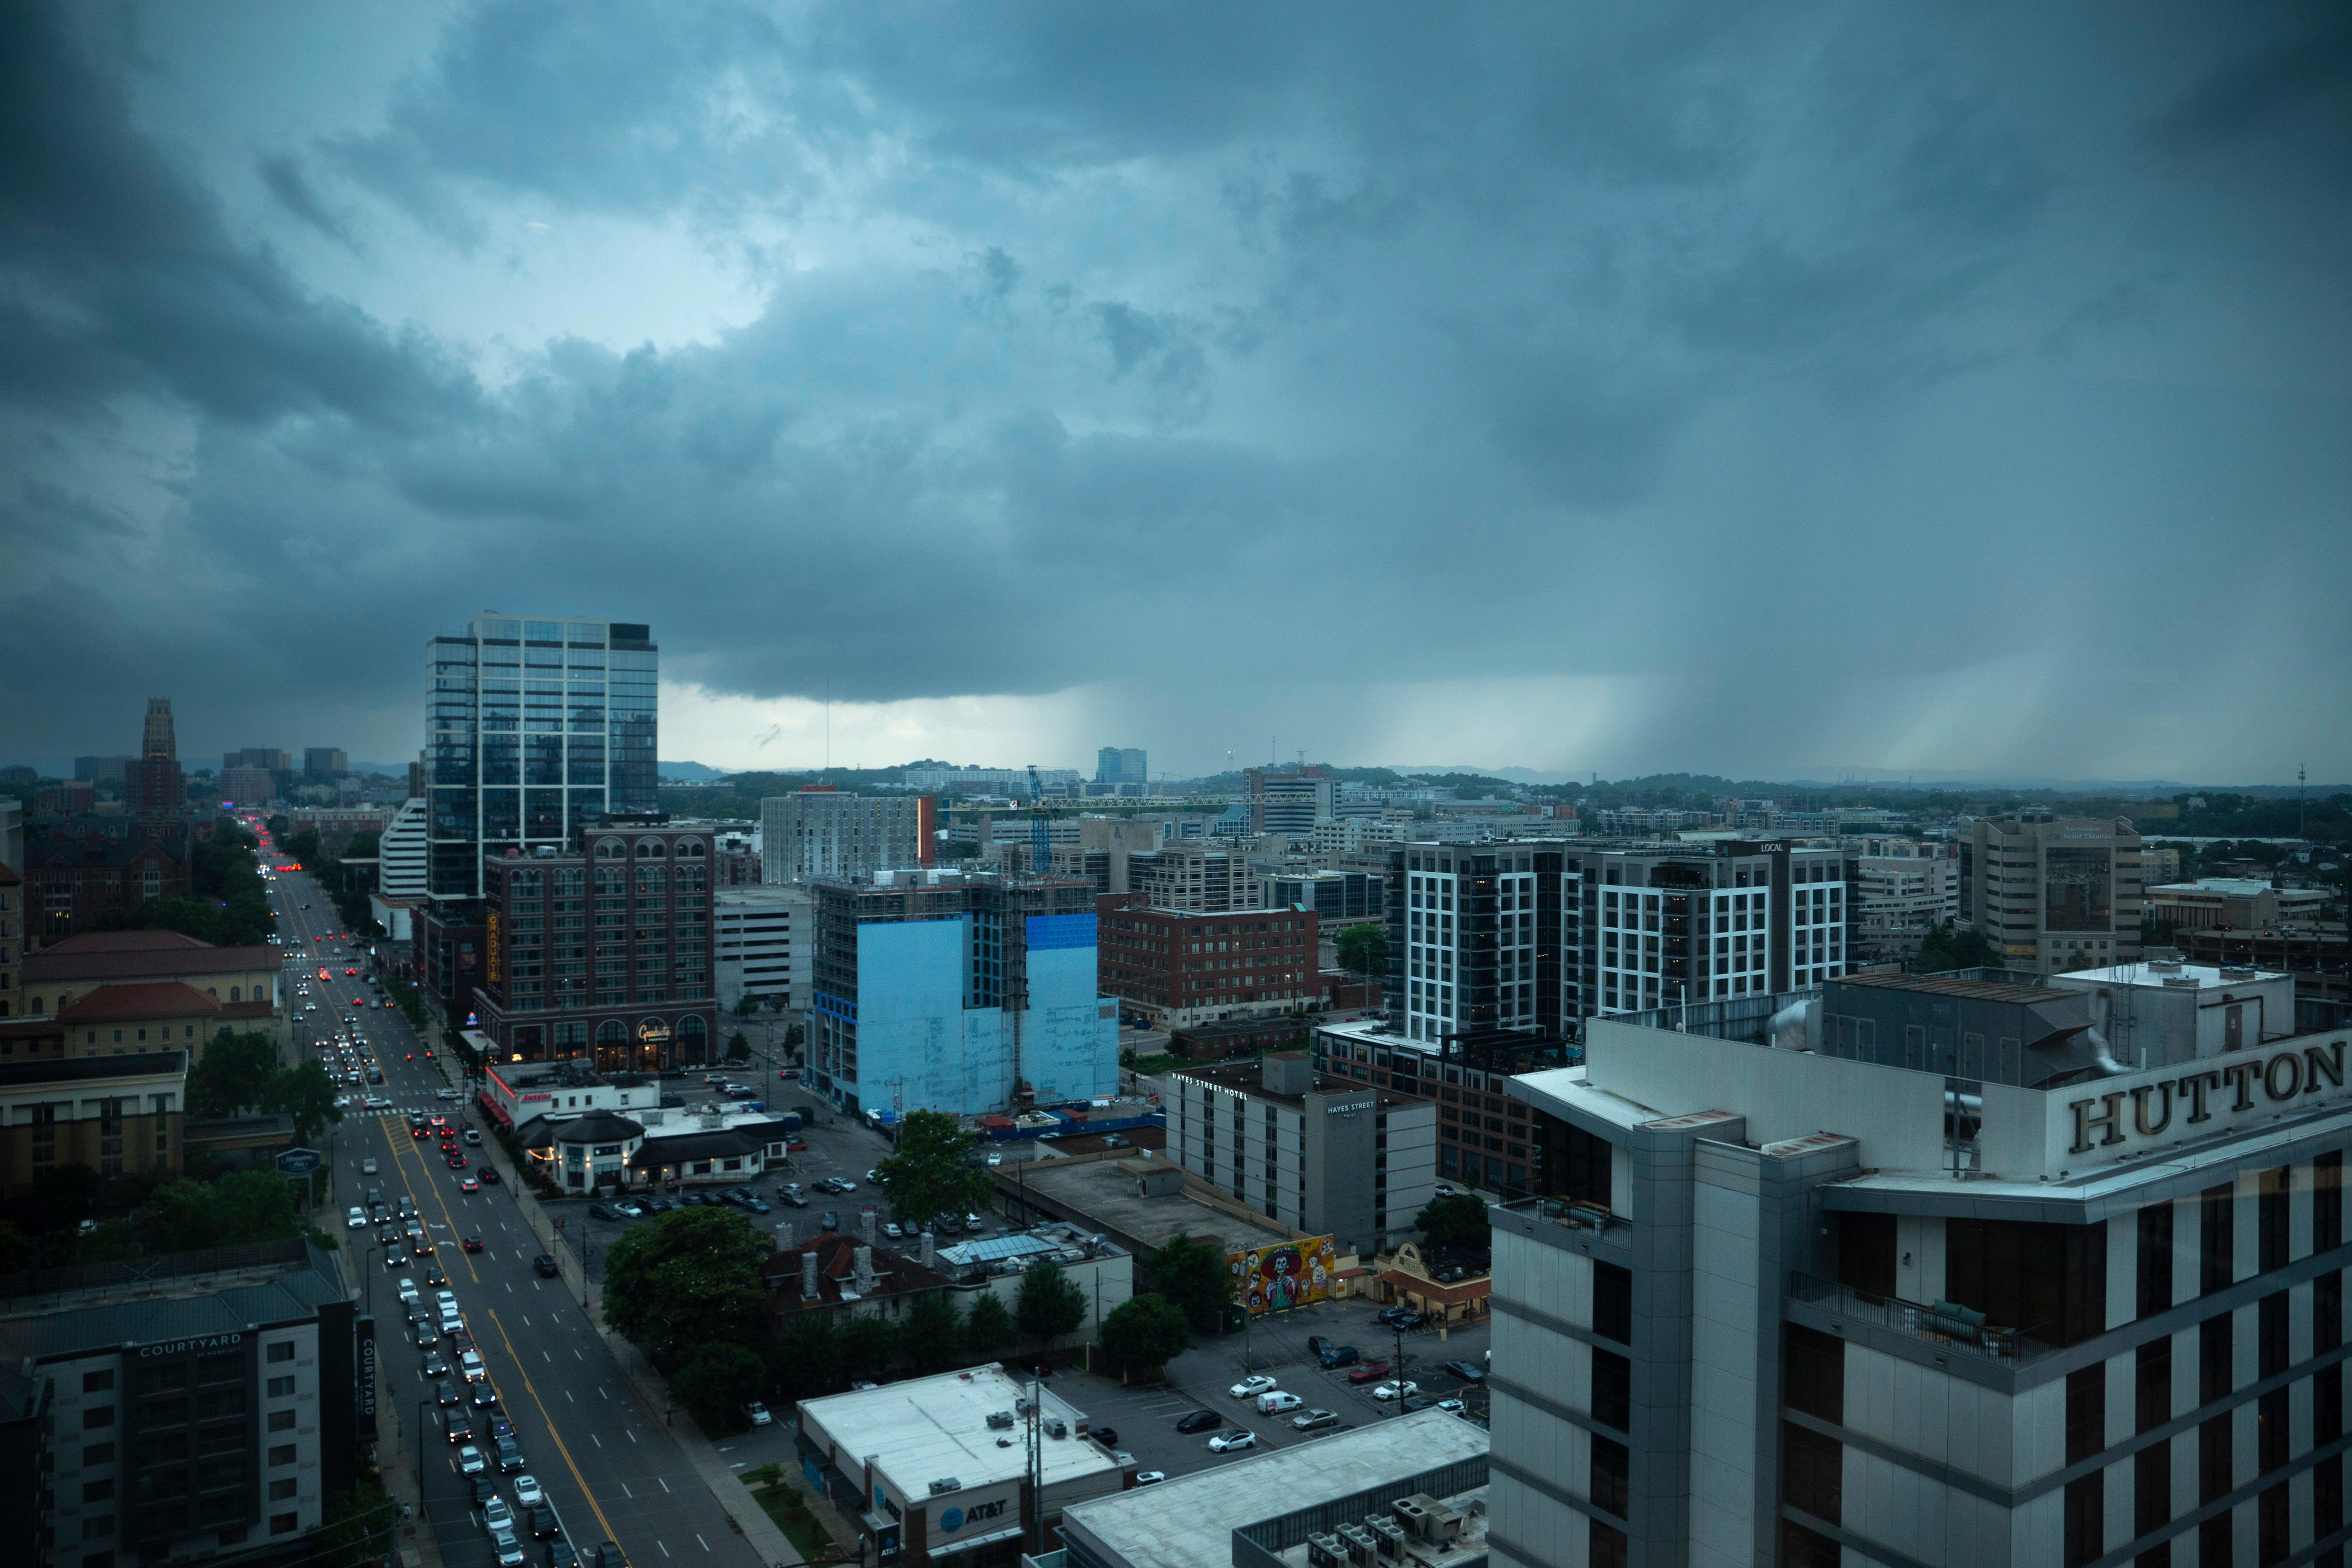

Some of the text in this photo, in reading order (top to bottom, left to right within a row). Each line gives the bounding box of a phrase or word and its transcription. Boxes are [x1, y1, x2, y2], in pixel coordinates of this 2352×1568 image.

[1761, 843, 1783, 852] LOCAL
[638, 1024, 671, 1042] Graduate
[1172, 1072, 1248, 1101] HAYES STREET HOTEL
[2068, 1041, 2347, 1154] HUTTON
[1328, 1101, 1374, 1114] HAYES STREET
[140, 1334, 241, 1358] COURTYARD
[363, 1339, 375, 1415] COURTYARD
[885, 1497, 902, 1523] AT&T
[966, 1499, 1007, 1524] AT&T
[881, 1546, 898, 1557] AT&T
